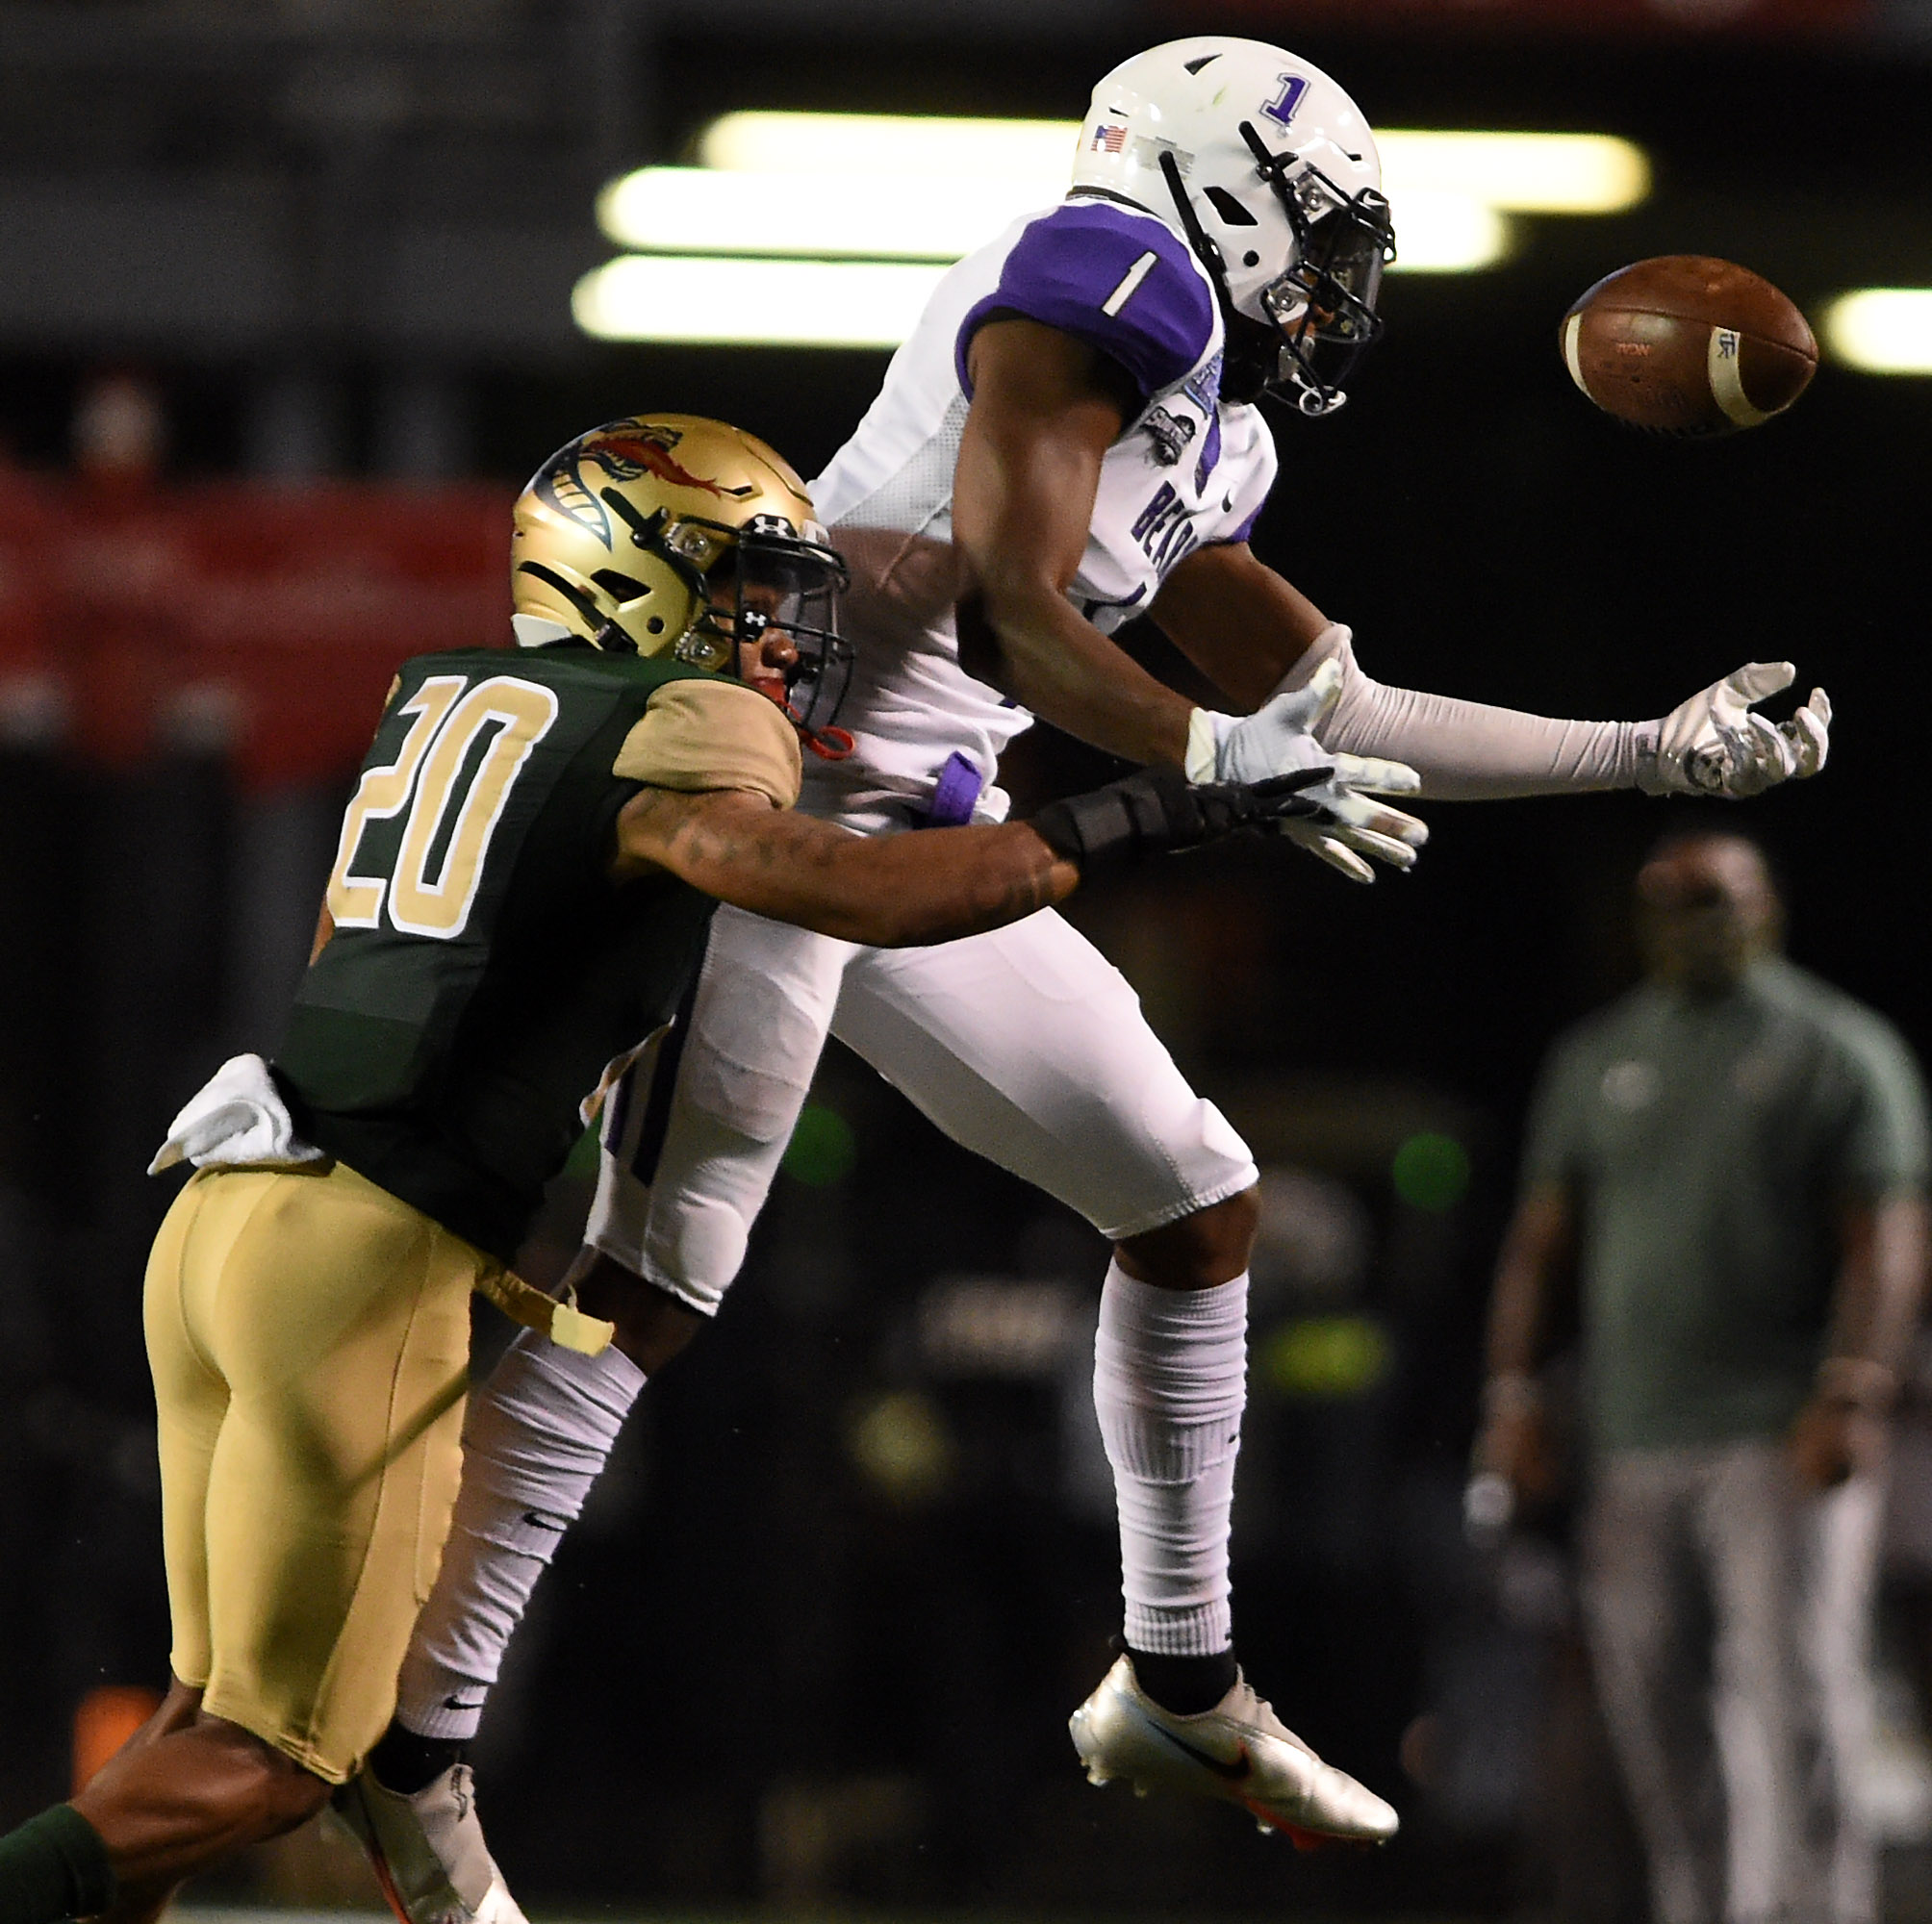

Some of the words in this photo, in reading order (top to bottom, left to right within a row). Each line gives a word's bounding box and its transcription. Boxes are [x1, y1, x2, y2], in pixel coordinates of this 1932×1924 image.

[1258, 72, 1311, 128] 1
[1101, 250, 1157, 318] 1
[326, 674, 559, 939] 20
